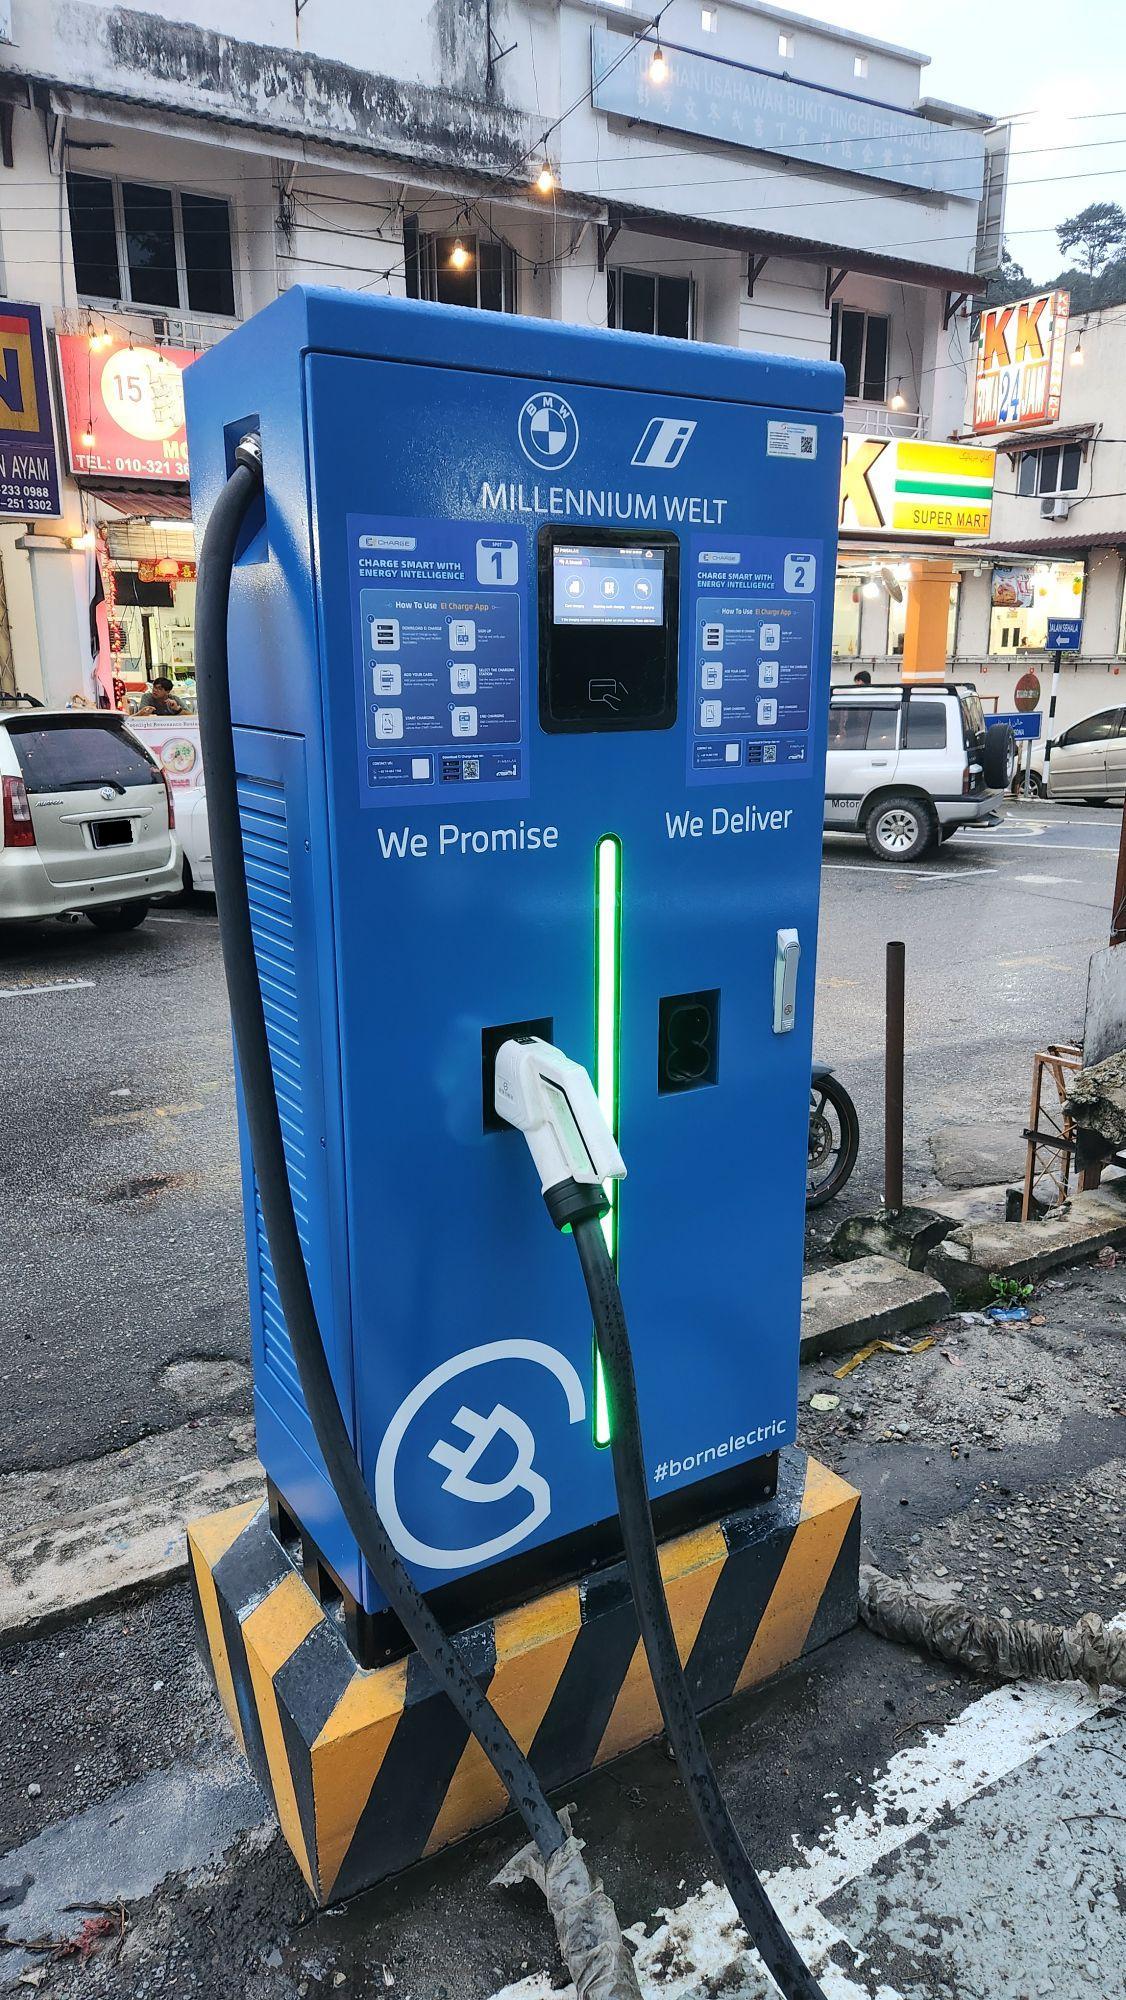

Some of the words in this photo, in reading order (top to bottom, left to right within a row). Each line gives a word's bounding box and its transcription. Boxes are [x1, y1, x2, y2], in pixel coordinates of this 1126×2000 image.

[704, 72, 783, 112] USAHAWAN
[787, 95, 825, 123] BUKIT
[828, 106, 870, 137] TINGGI
[873, 118, 930, 151] BENTONG
[984, 296, 1050, 369] KK
[114, 374, 142, 403] 15
[999, 368, 1020, 423] 24
[1020, 365, 1047, 415] JAM
[526, 396, 570, 420] BMW
[12, 455, 49, 481] AYAM
[76, 454, 112, 470] TEL:
[115, 457, 171, 474] 010-321
[0, 484, 21, 496] 233
[23, 486, 49, 498] 0988
[27, 499, 52, 511] 3302
[482, 482, 657, 520] MILLENNIUM
[663, 495, 728, 524] WELT
[913, 509, 953, 526] SUPER
[956, 512, 989, 528] MART
[358, 558, 399, 568] CHARGE
[401, 560, 434, 570] SMART
[436, 561, 461, 571] WITH
[359, 568, 398, 578] ENERGY
[400, 570, 465, 580] INTELLIGENCE
[491, 551, 503, 580] 1
[697, 571, 727, 580] CHARGE
[728, 573, 753, 581] SMART
[754, 573, 773, 581] WITH
[697, 580, 725, 588] ENERGY
[727, 581, 775, 590] INTELLIGENCE
[794, 566, 805, 588] 2
[395, 601, 413, 609] How
[413, 601, 423, 609] To
[423, 602, 438, 610] Use
[448, 603, 474, 612] Charge
[474, 603, 489, 612] App
[1049, 623, 1063, 633] JALAN
[831, 799, 860, 809] Motor
[665, 810, 704, 839] We
[711, 805, 793, 835] Deliver
[377, 827, 428, 859] We
[439, 820, 559, 855] Promise
[653, 1419, 787, 1483] #bornelectric
